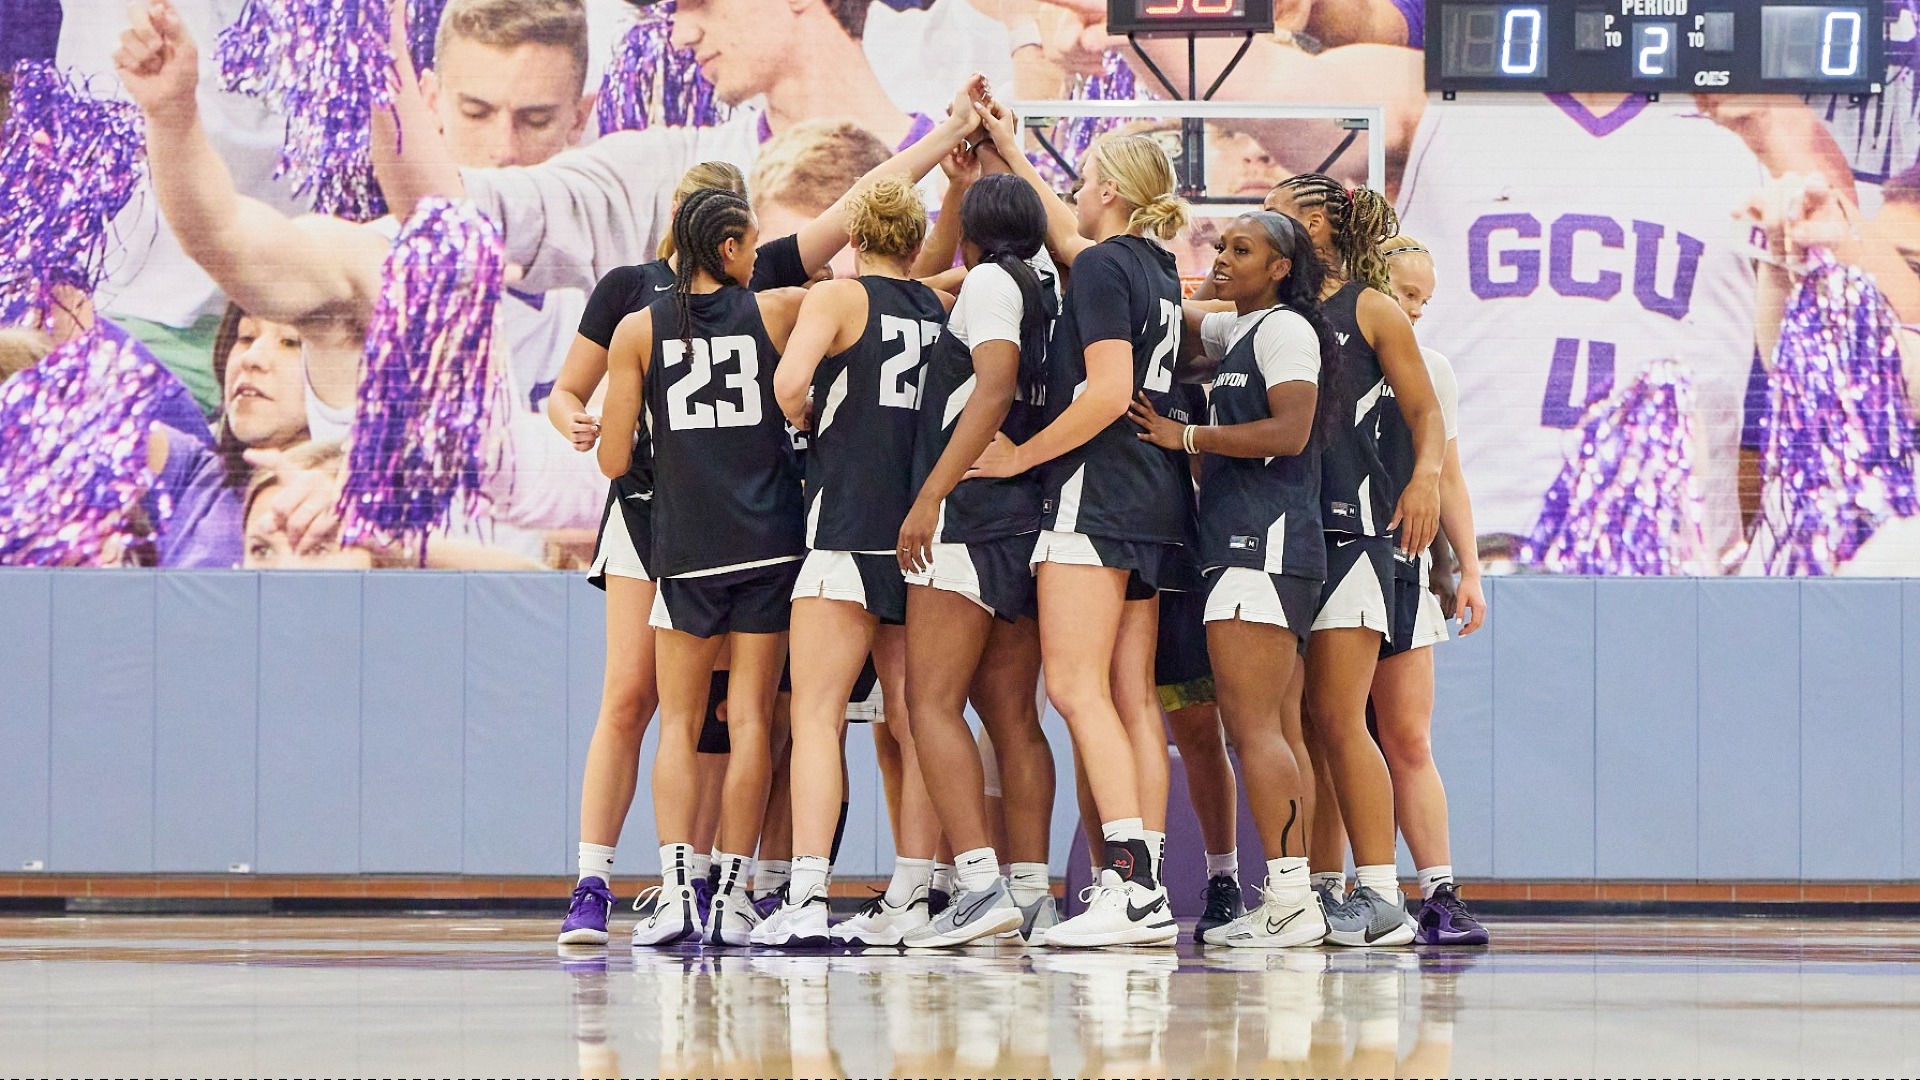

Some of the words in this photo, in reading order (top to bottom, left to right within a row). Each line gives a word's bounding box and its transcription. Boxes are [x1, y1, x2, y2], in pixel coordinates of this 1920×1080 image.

[1621, 0, 1687, 16] PERIOD
[1501, 9, 1541, 74] 0
[1604, 31, 1623, 48] TO
[1639, 27, 1669, 75] 2
[1687, 32, 1705, 48] TO
[1821, 12, 1861, 75] 0
[1694, 71, 1731, 87] OES
[1467, 212, 1704, 321] GCU
[662, 334, 763, 431] 23
